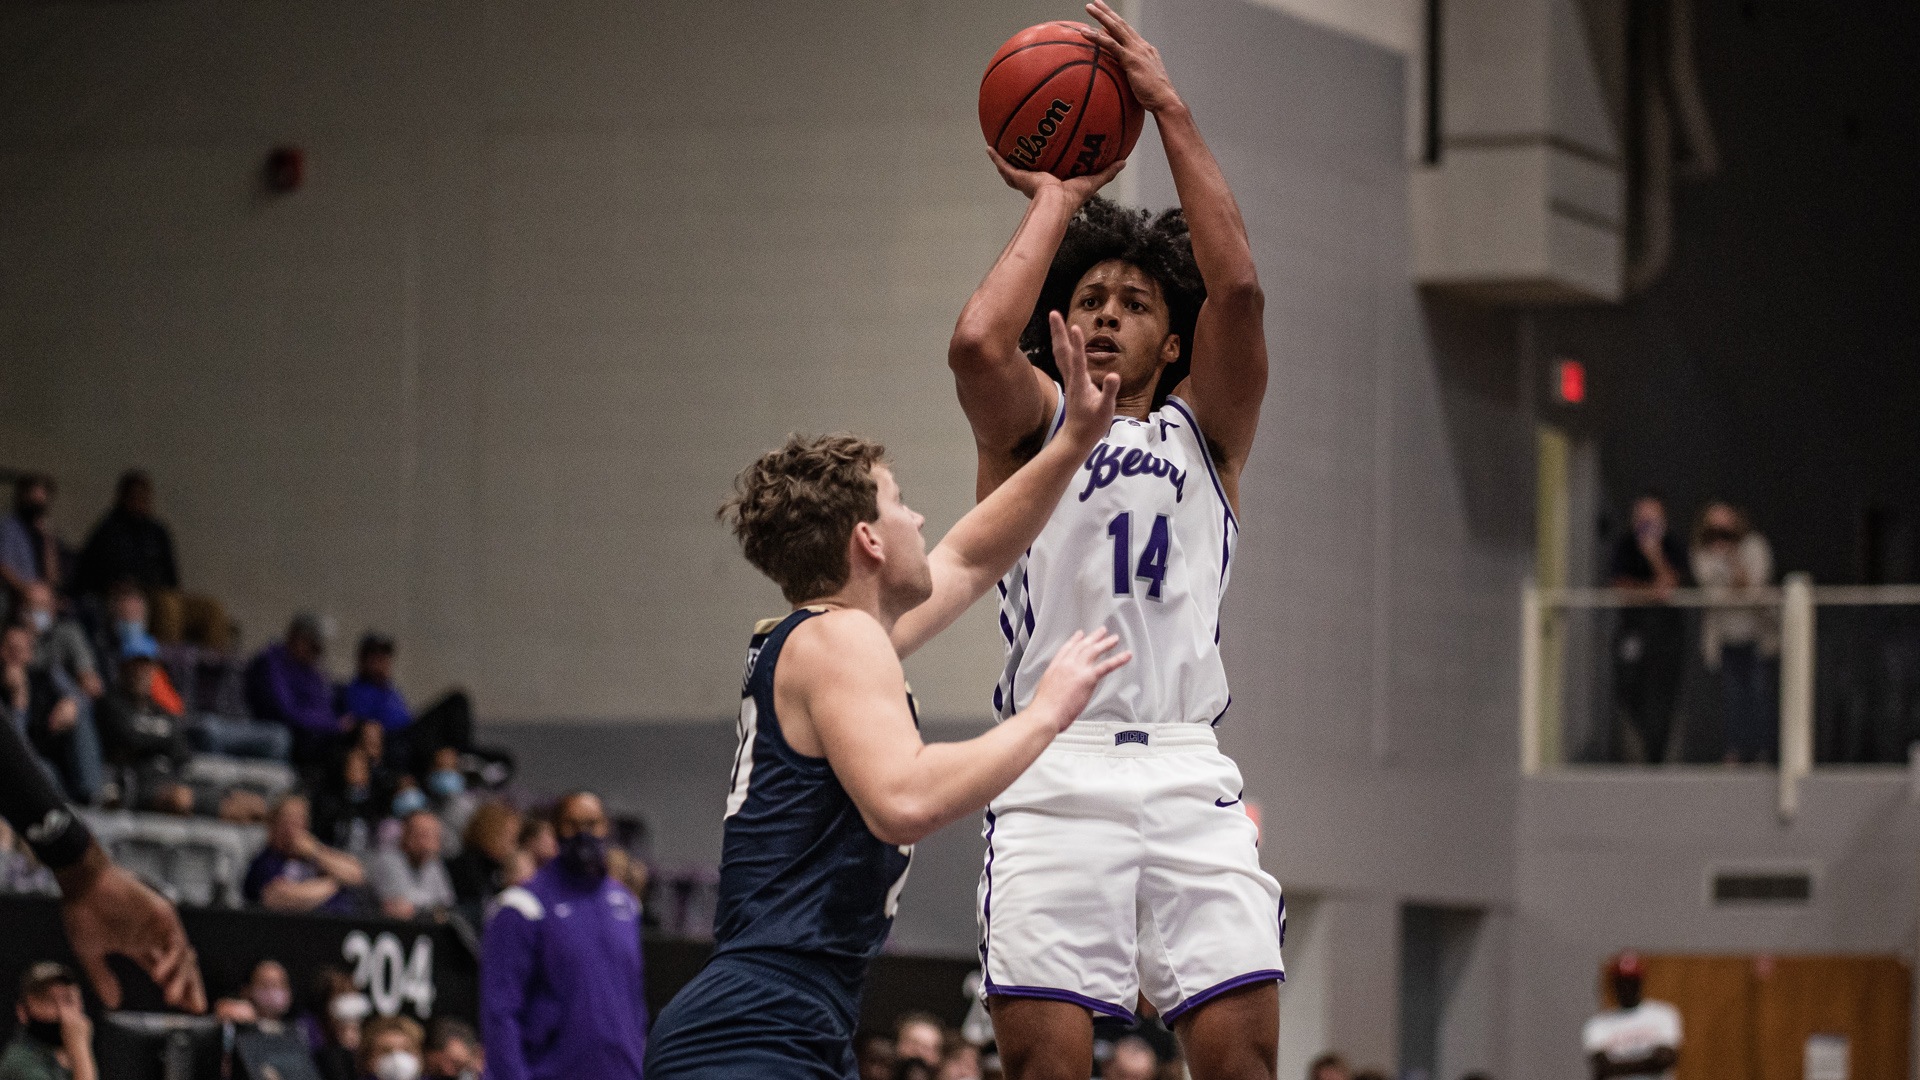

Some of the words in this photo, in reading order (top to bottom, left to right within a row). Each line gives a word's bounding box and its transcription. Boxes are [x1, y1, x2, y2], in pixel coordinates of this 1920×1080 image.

[1007, 98, 1073, 171] ilson
[1063, 134, 1106, 179] CAA
[1106, 510, 1172, 603] 14
[1115, 730, 1149, 746] UCA
[341, 929, 437, 1019] 204
